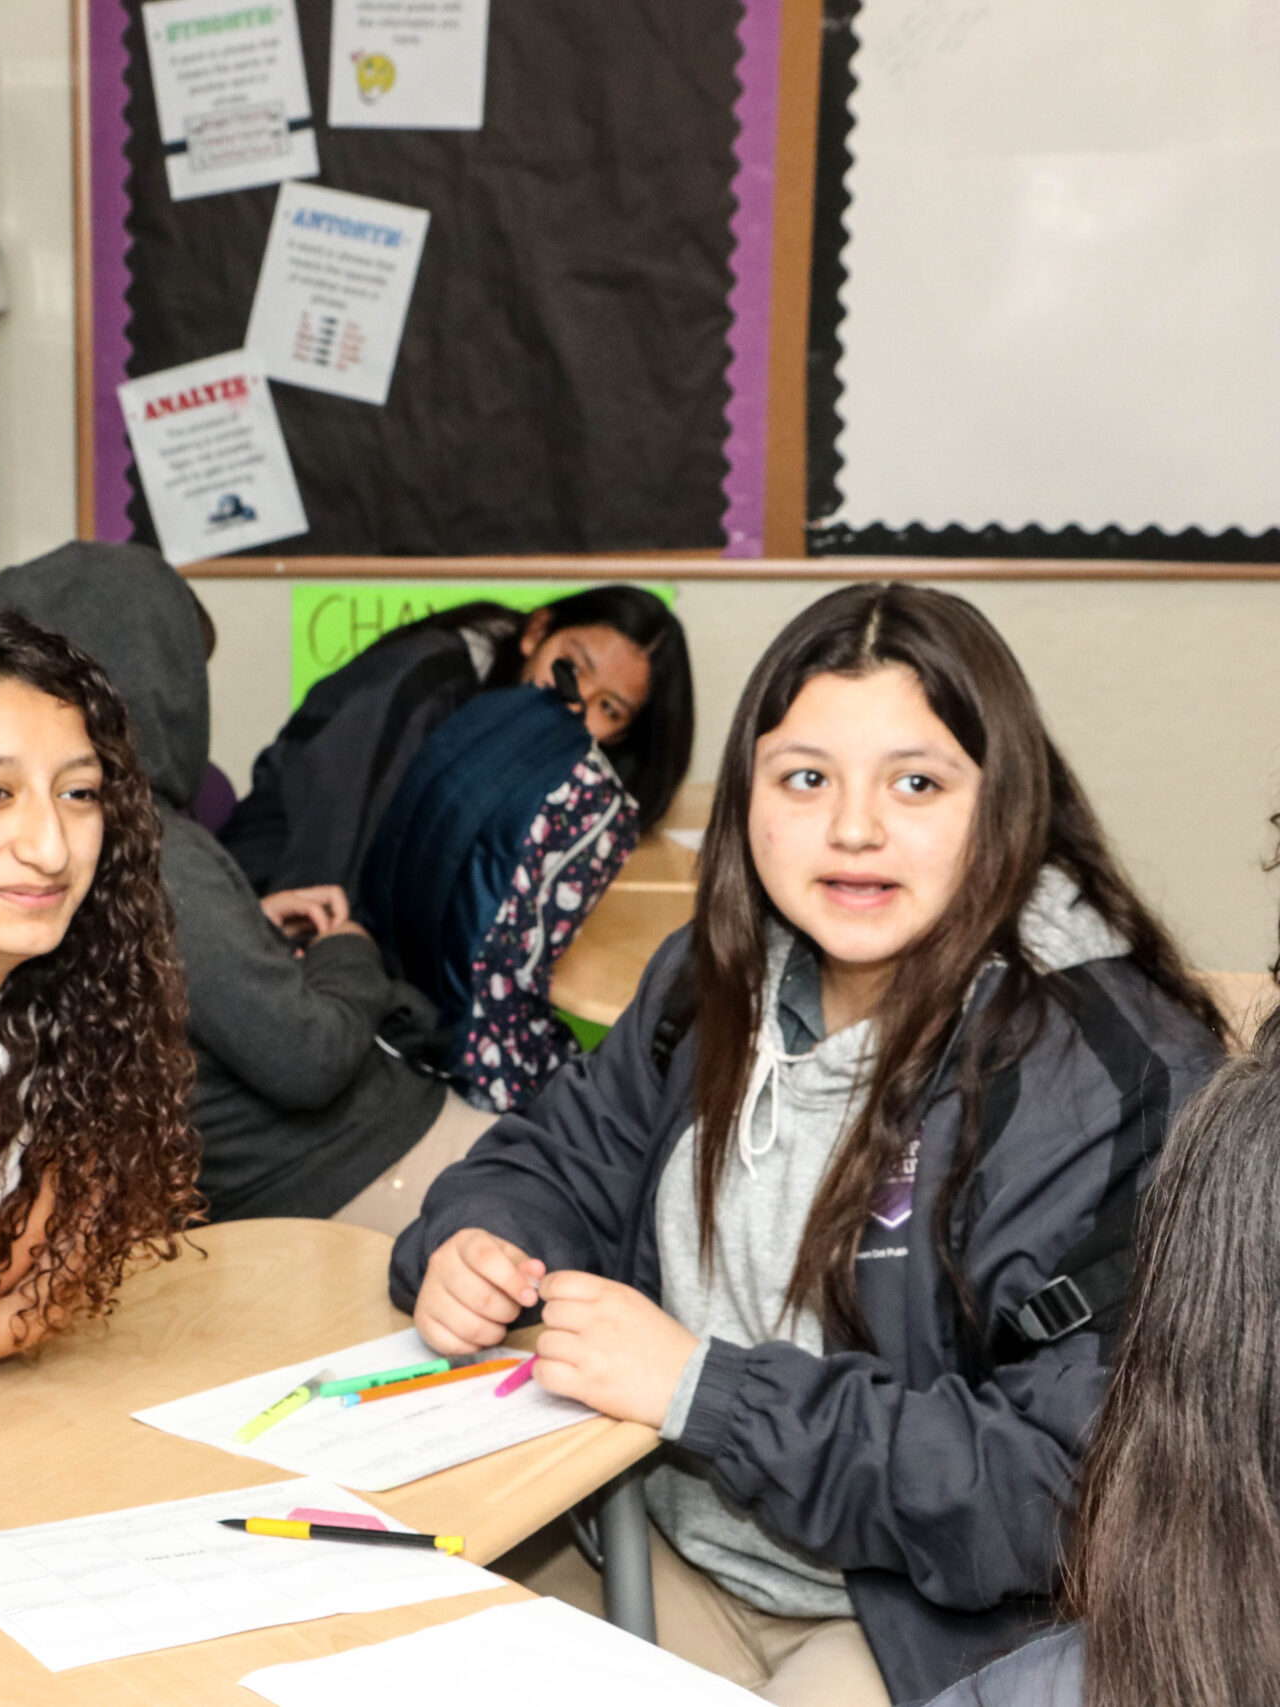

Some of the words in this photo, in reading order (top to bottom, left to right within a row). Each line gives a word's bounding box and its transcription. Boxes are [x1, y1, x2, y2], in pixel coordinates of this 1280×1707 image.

[291, 207, 404, 248] ANTONYM
[143, 376, 248, 422] ANALYZE
[307, 593, 434, 667] CHA
